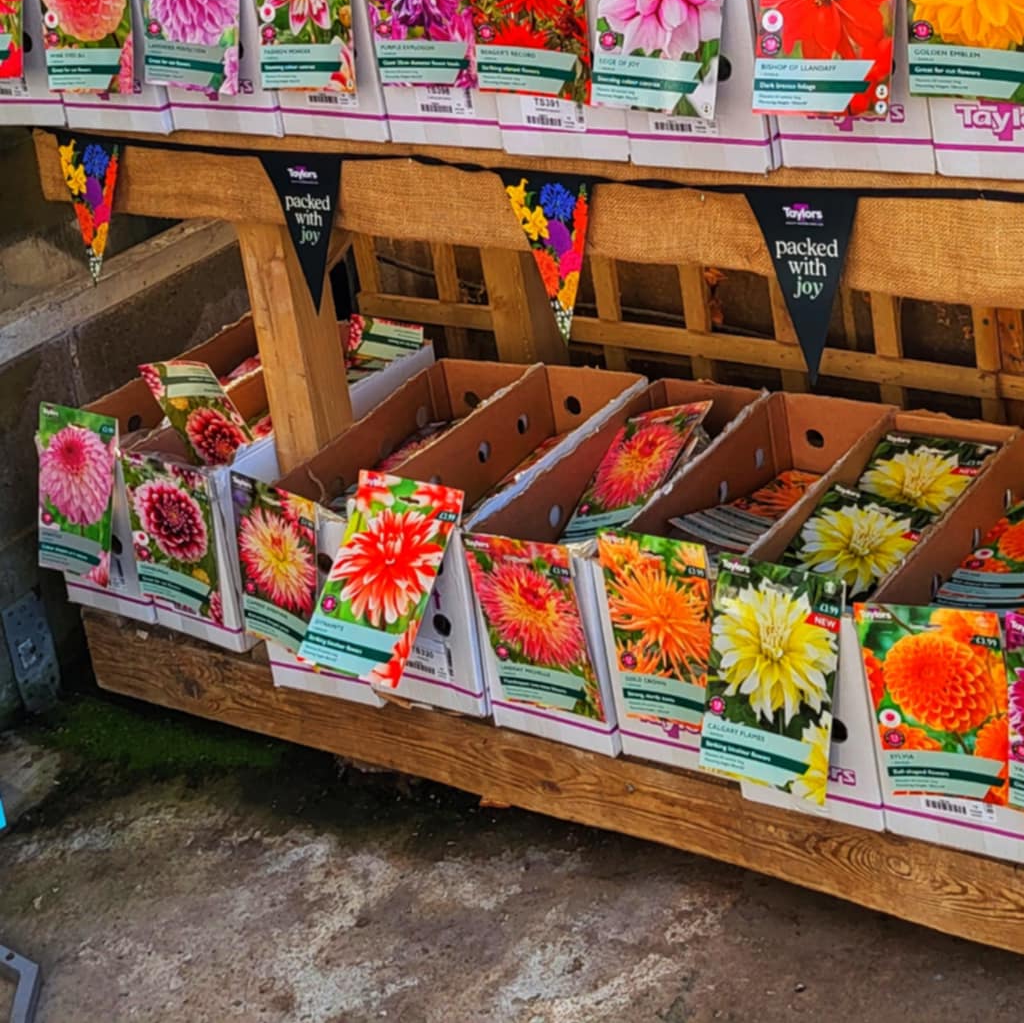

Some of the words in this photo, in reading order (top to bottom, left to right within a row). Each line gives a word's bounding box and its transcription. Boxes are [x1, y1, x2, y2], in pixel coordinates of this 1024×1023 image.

[914, 48, 945, 57] GOLDEN
[947, 50, 981, 58] EMBLEM
[761, 63, 787, 72] BISHOP
[788, 63, 797, 72] OF
[287, 168, 318, 180] Taylors
[285, 194, 330, 211] packed
[295, 211, 323, 226] with
[782, 206, 823, 220] Taylors
[300, 227, 319, 245] joy
[775, 238, 839, 259] packed
[788, 258, 827, 276] with
[793, 277, 823, 300] joy
[814, 617, 836, 627] NEW
